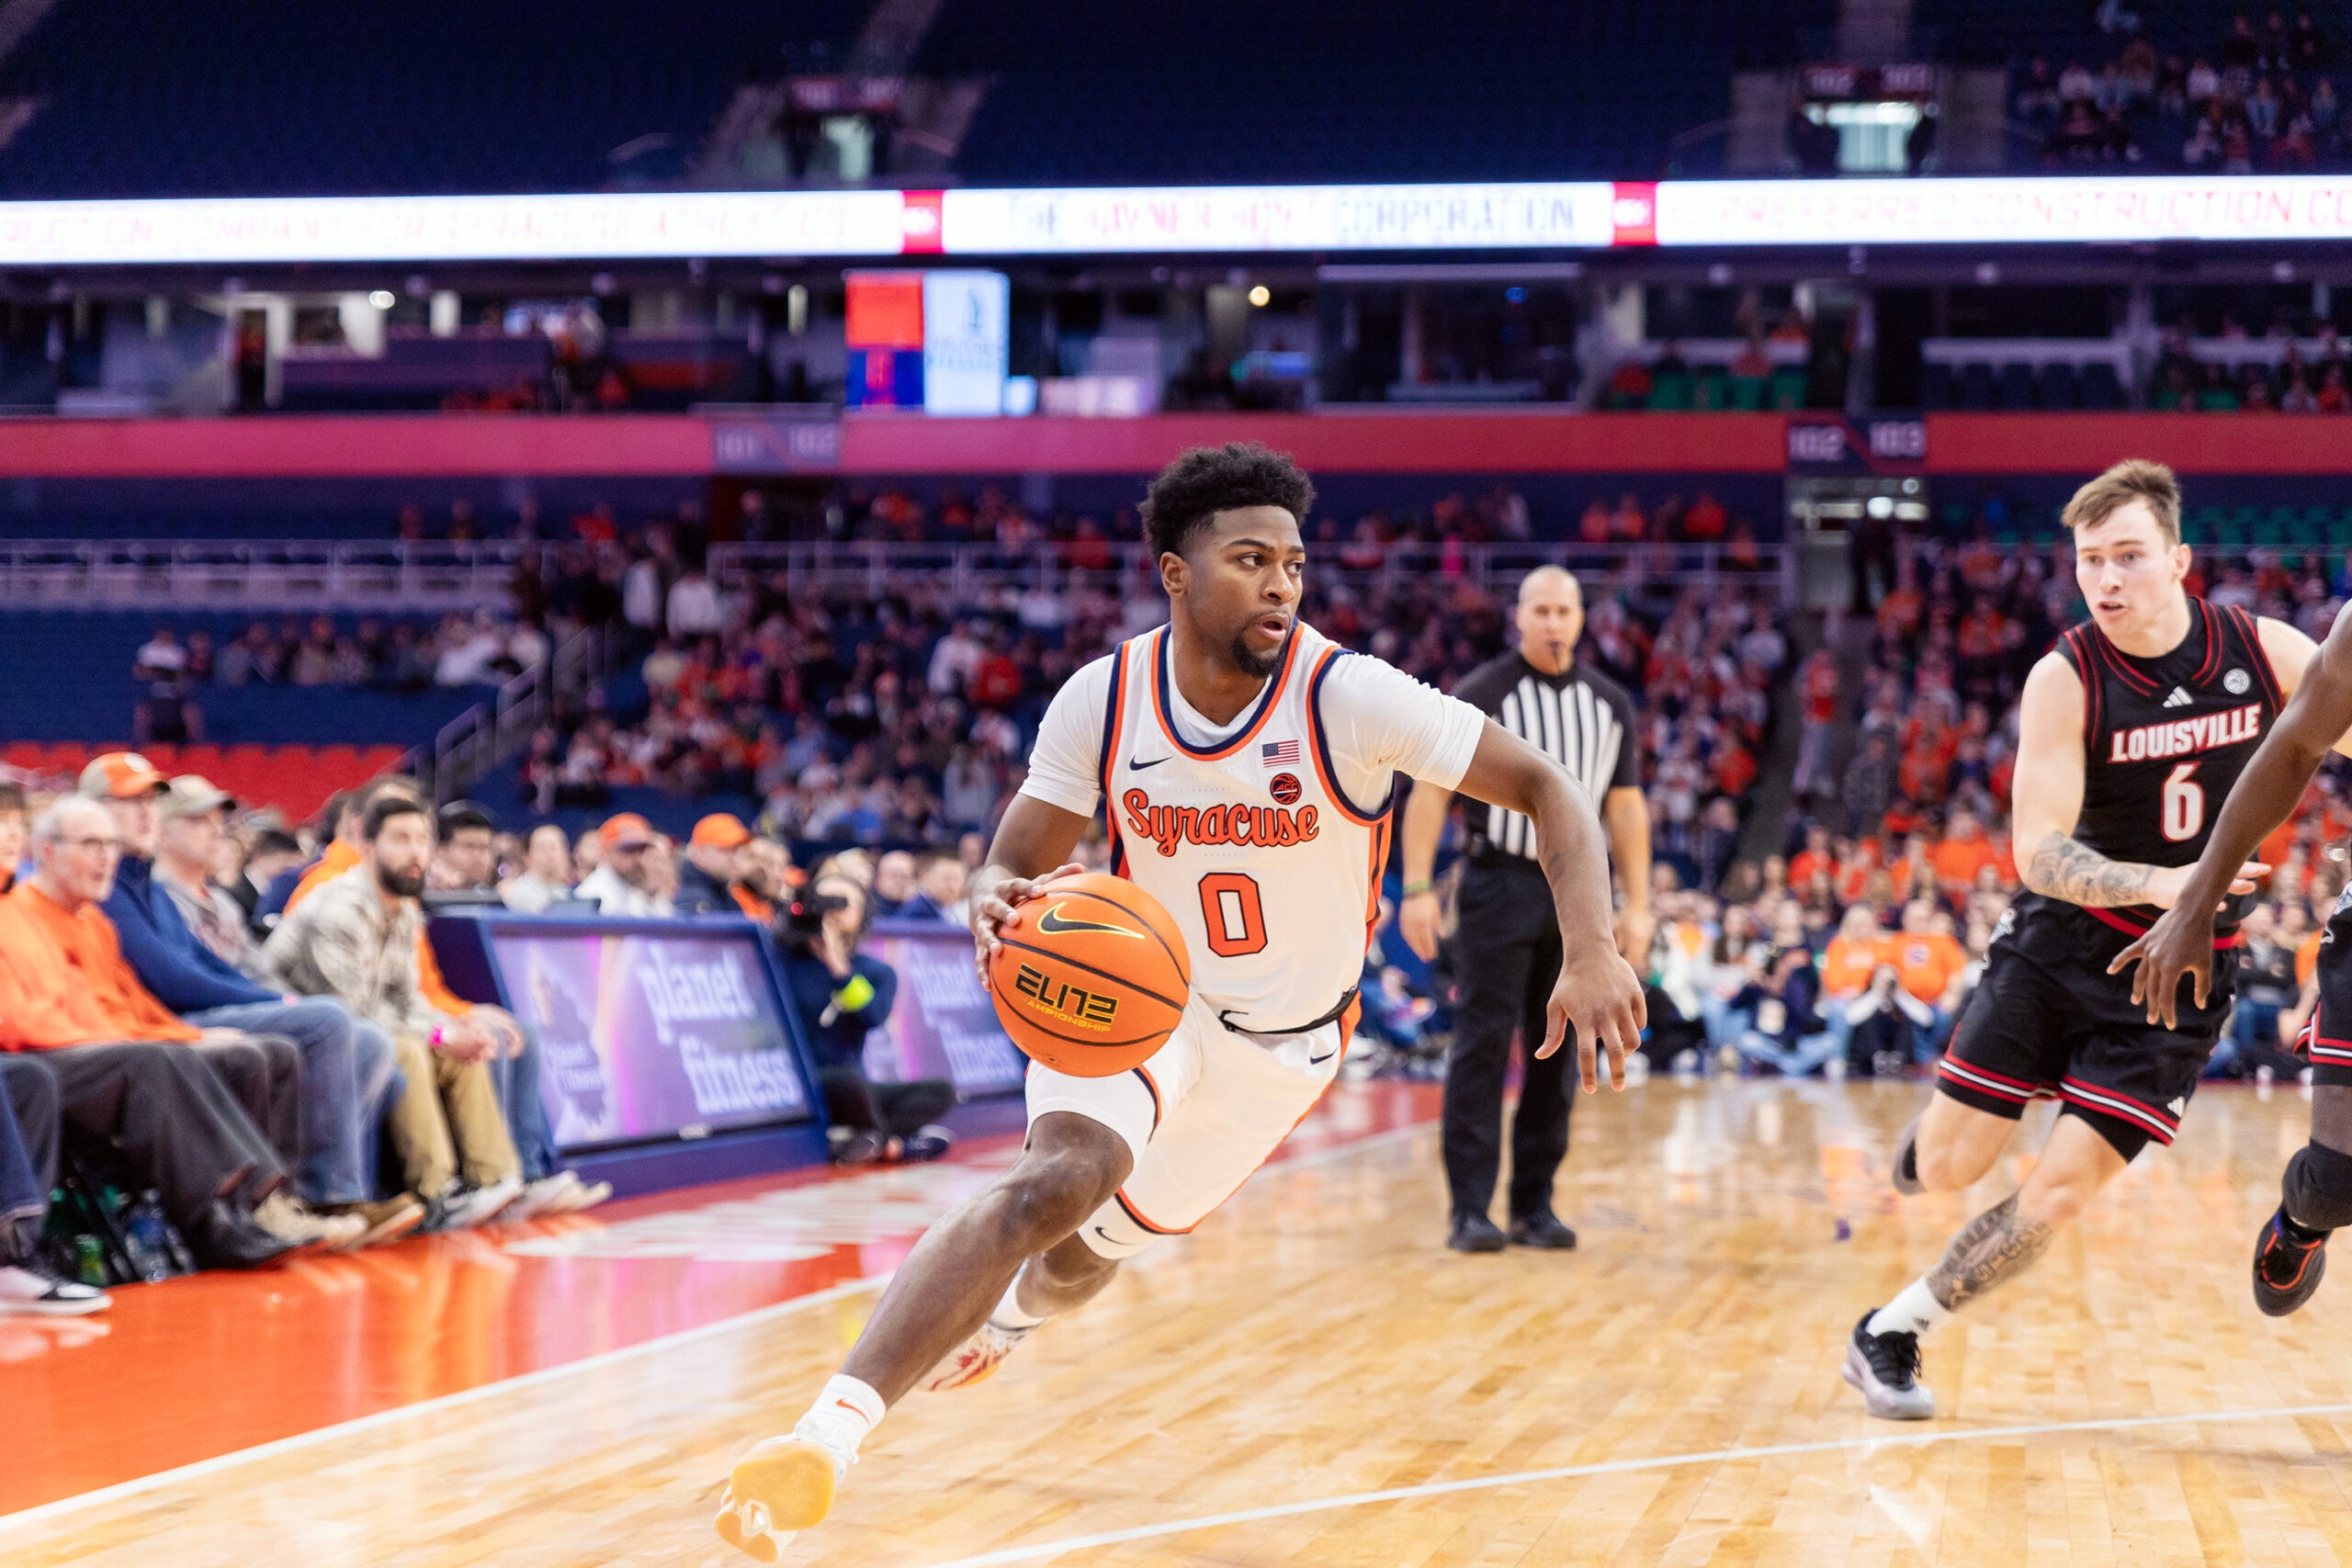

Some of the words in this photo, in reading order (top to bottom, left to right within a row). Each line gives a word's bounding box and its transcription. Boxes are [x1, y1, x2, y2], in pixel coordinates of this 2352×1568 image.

[2107, 702, 2262, 764] LOUISVILLE
[1123, 788, 1319, 857] Syracuse
[2160, 761, 2204, 842] 6
[1198, 873, 1267, 957] 0
[1015, 962, 1119, 1025] ELITE
[1017, 995, 1112, 1032] AMPIONSHIP
